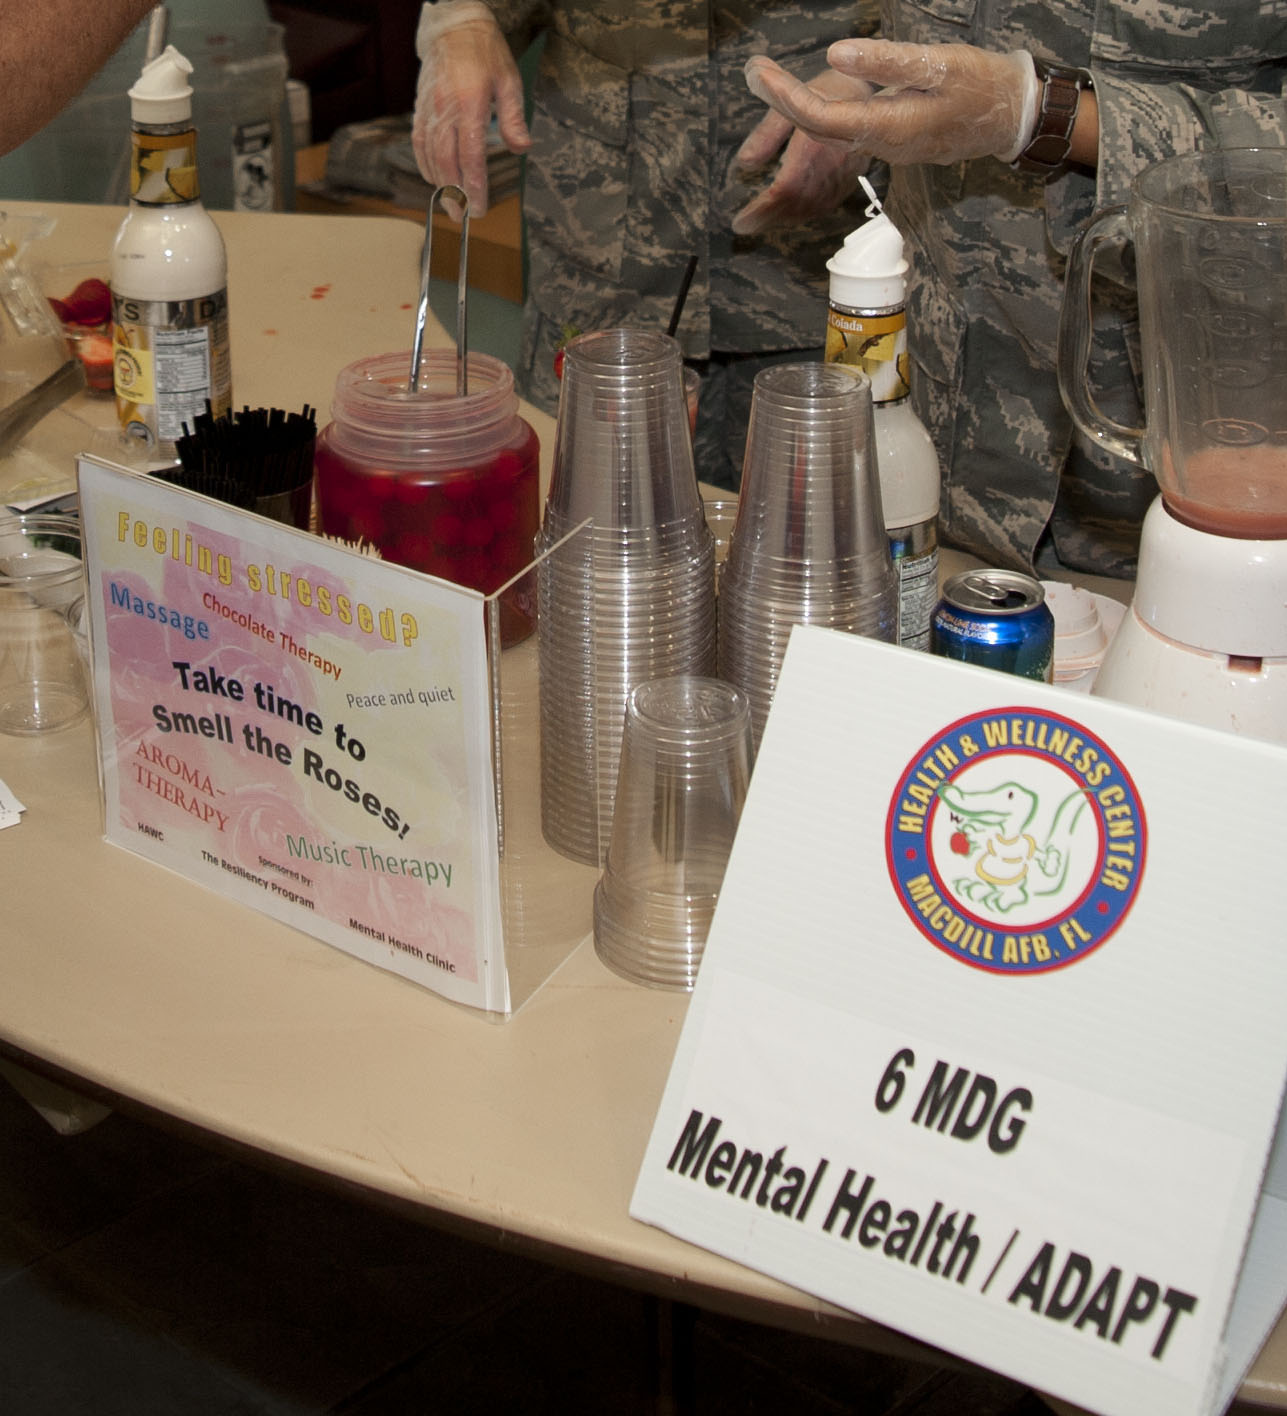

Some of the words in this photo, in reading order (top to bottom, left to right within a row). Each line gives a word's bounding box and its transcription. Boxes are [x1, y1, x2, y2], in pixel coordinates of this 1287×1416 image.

[110, 582, 210, 640] Massage
[117, 512, 233, 586] Feeling
[247, 564, 418, 647] stressed?
[202, 592, 275, 644] Chocolate
[280, 632, 342, 680] Therapy
[173, 661, 244, 702] Take
[254, 682, 323, 735] time
[334, 724, 366, 762] to
[346, 693, 386, 708] Peace
[390, 688, 415, 706] and
[418, 687, 456, 707] quiet
[133, 763, 230, 832] THERAPY
[136, 739, 227, 797] AROMA-
[152, 704, 234, 744] Smell
[243, 723, 292, 766] the
[303, 748, 411, 840] Roses!
[898, 743, 960, 834] HEALTH
[959, 736, 980, 757] &
[982, 718, 1111, 786] WELLNESS
[1098, 784, 1136, 892] CENTER
[138, 822, 164, 841] HAWC
[286, 834, 353, 868] Music
[356, 845, 453, 889] Therapy
[201, 850, 219, 867] The
[221, 856, 269, 891] Resiliency
[271, 882, 315, 911] Program
[906, 873, 995, 961] MACDILL
[1059, 917, 1093, 951] FL
[349, 918, 386, 942] Mental
[388, 935, 424, 959] Health
[426, 952, 456, 974] Clinic
[873, 1047, 916, 1113] 6
[911, 1059, 1034, 1155] MDG
[666, 1108, 830, 1223] Mental
[821, 1168, 982, 1286] Health
[980, 1228, 1021, 1295] /
[1007, 1240, 1199, 1362] ADAPT
